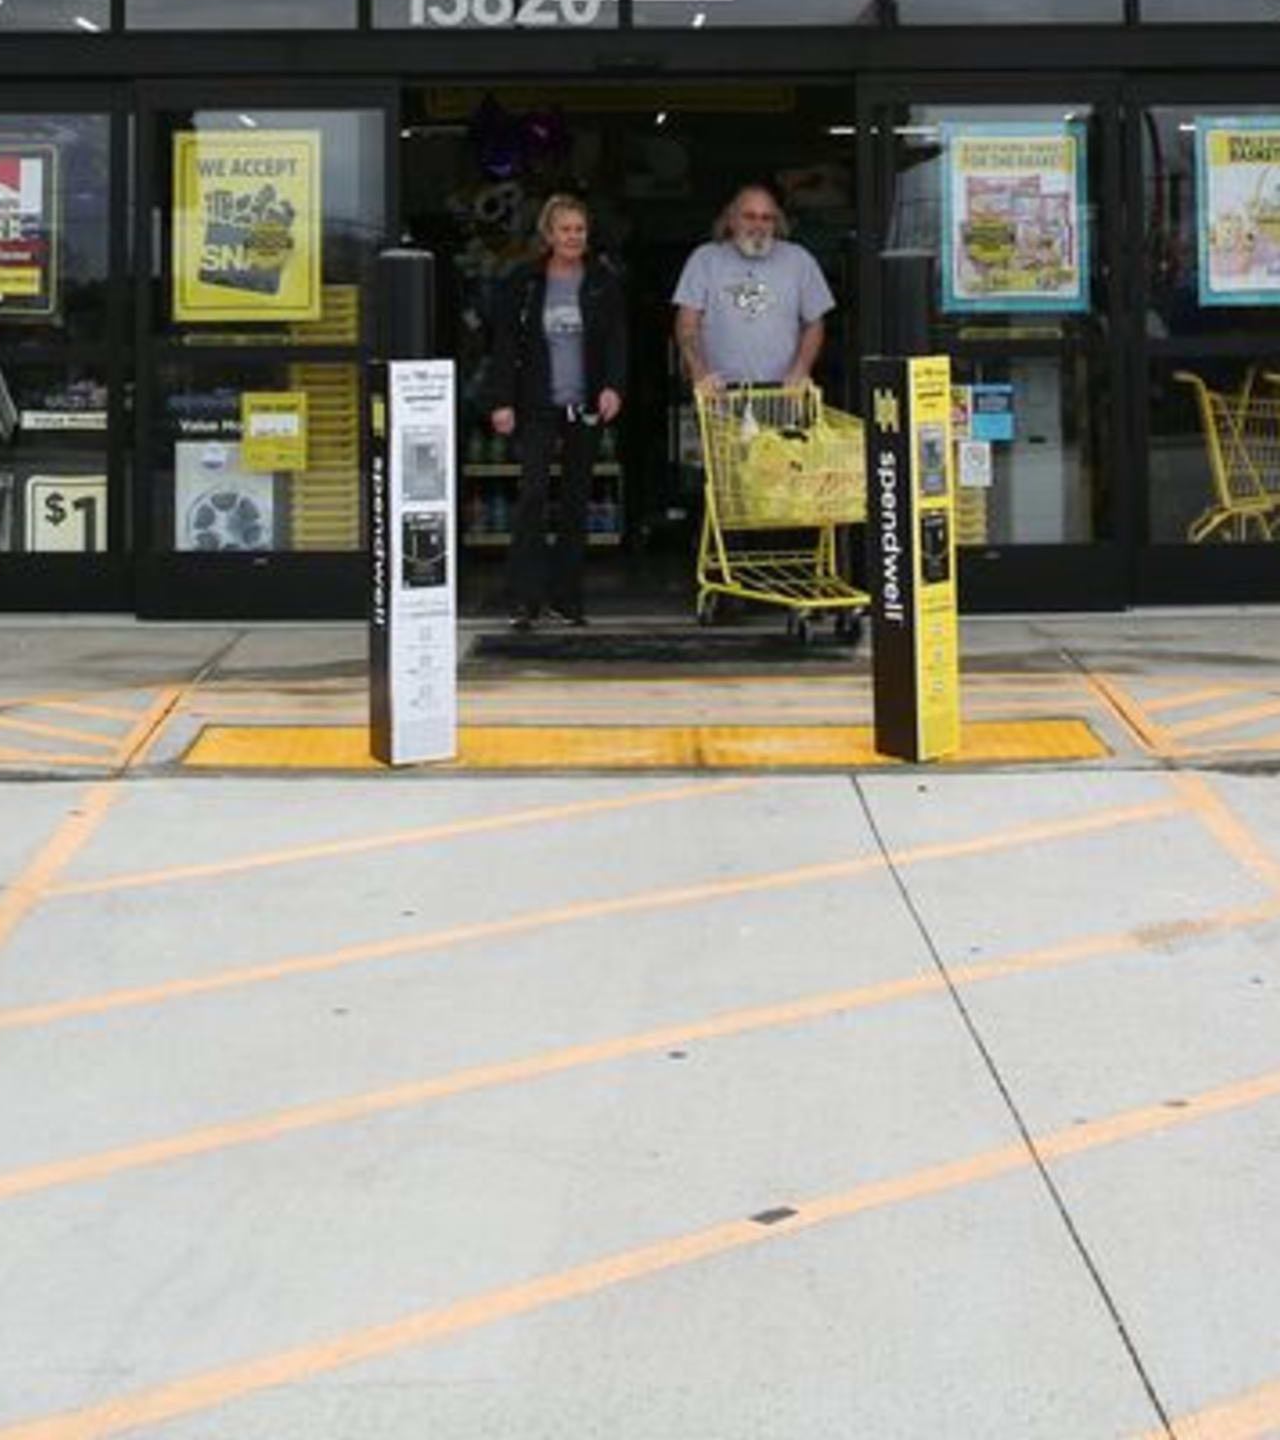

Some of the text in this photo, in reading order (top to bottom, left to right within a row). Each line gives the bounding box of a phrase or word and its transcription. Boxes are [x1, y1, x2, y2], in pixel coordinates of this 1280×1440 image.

[197, 158, 298, 177] WE ACCEPT
[201, 244, 252, 272] SN
[44, 491, 97, 552] $1
[877, 451, 905, 622] spendwell
